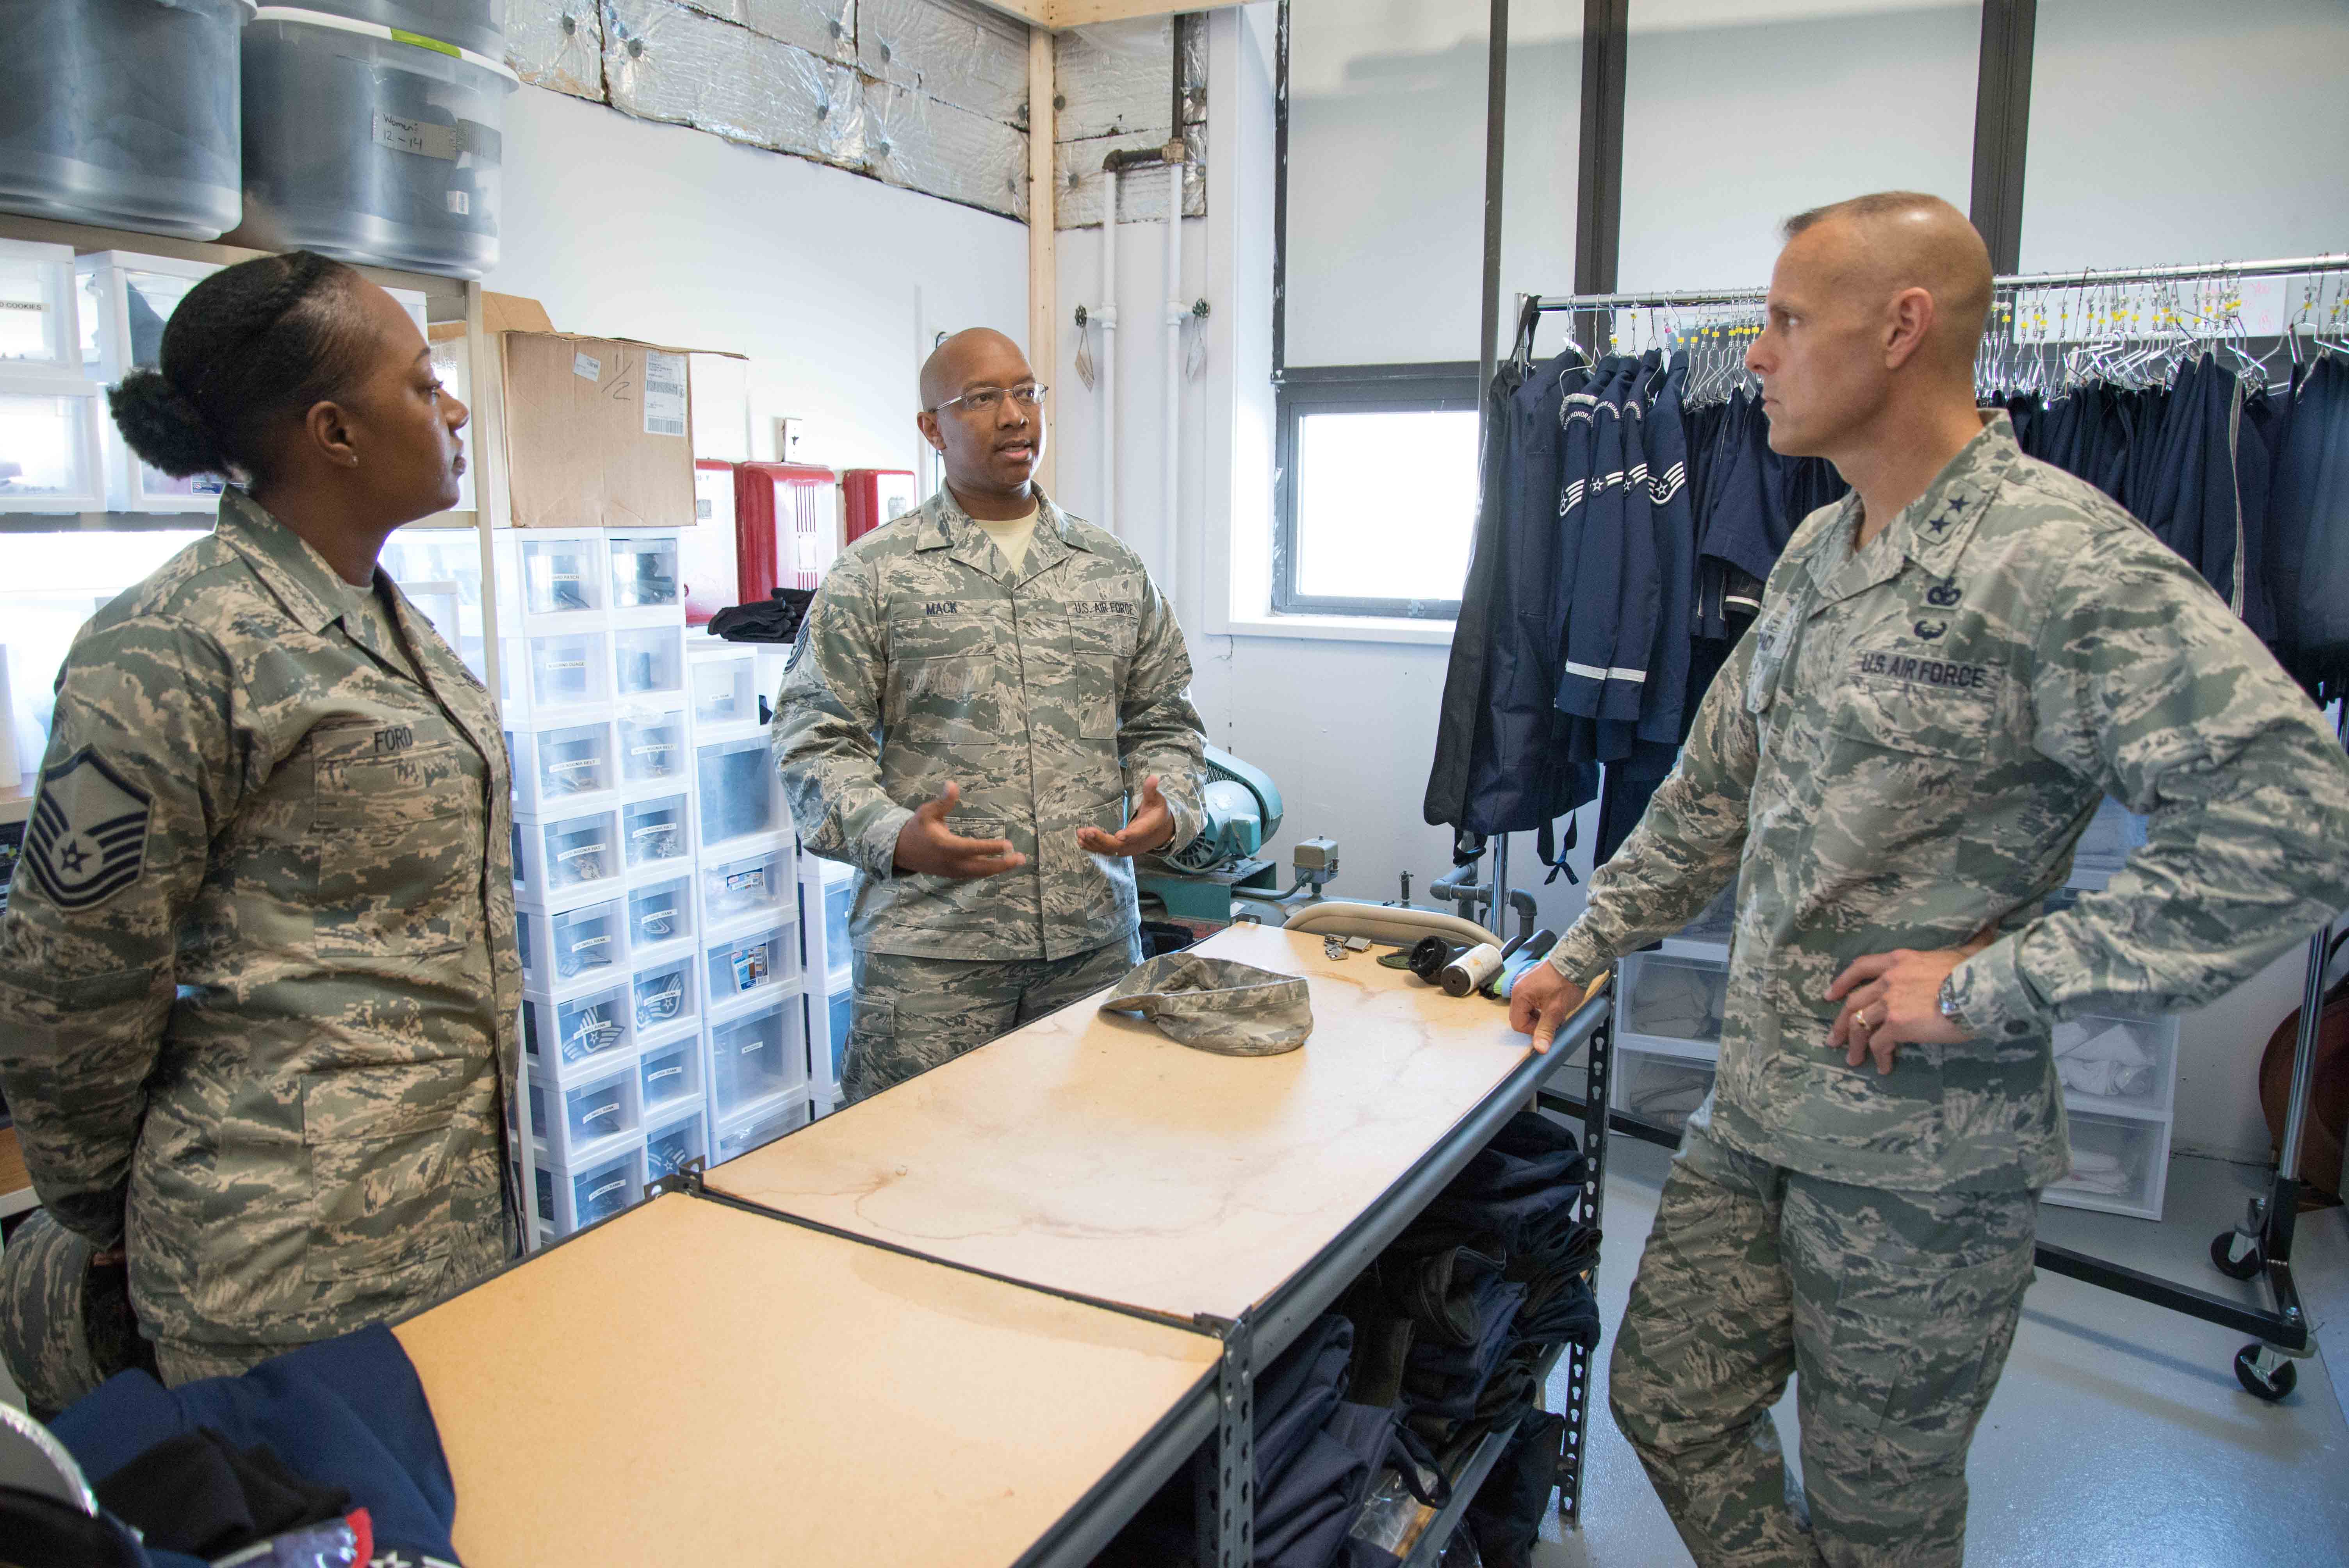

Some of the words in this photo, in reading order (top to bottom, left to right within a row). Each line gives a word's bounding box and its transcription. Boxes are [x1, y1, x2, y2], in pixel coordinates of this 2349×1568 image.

[384, 130, 394, 141] 12
[1607, 403, 1620, 419] GUARD
[1630, 402, 1641, 419] GUARD
[926, 602, 957, 615] MACK
[1074, 602, 1093, 614] U.S.
[1095, 602, 1109, 613] AIR
[1109, 602, 1134, 615] FORCE
[1861, 652, 1886, 674] U.S.
[1887, 656, 1917, 680] AIR
[1918, 660, 1988, 689] FORCE
[374, 727, 413, 753] FORD
